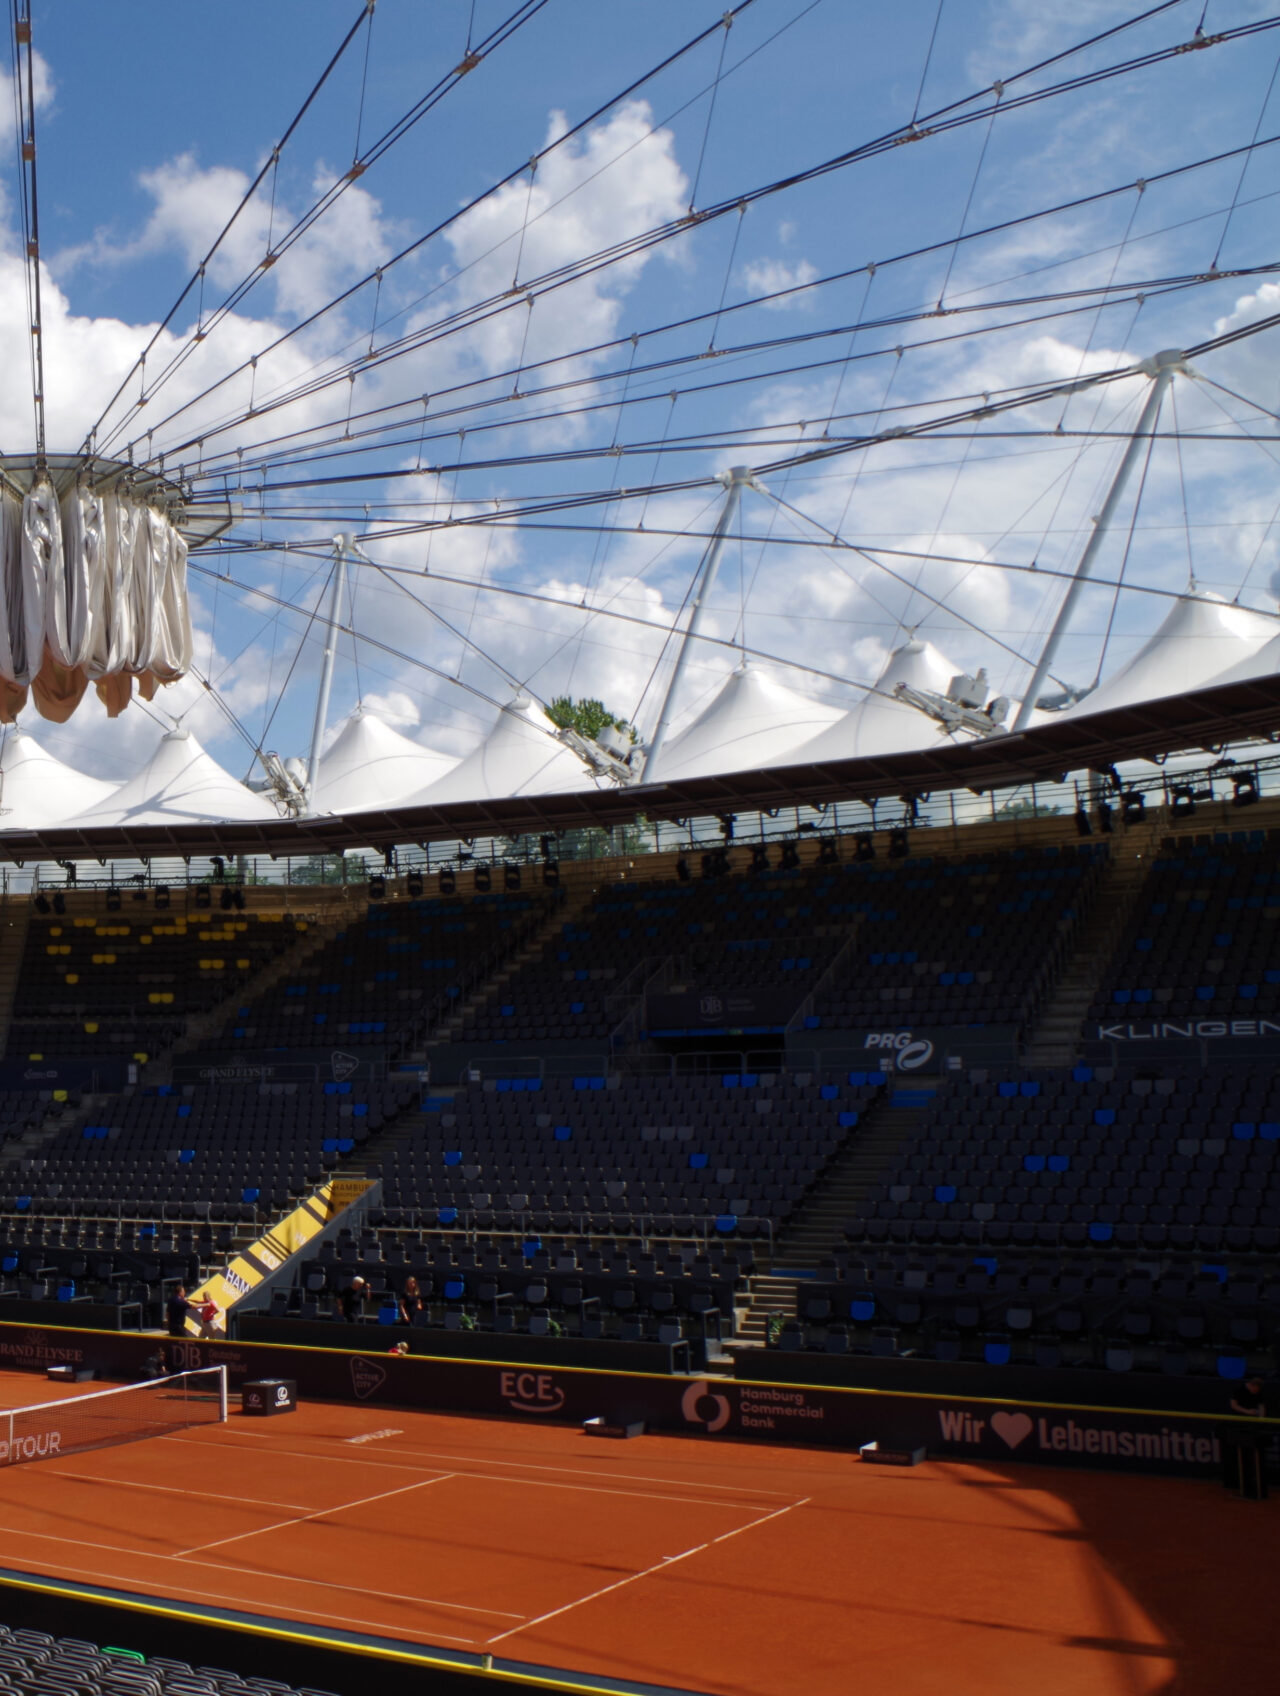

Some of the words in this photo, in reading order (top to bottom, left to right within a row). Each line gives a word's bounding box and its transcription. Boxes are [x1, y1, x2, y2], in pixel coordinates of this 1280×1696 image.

[864, 1032, 912, 1049] PRG
[171, 1341, 202, 1370] DTB
[355, 1373, 380, 1383] ACTIVE
[356, 1381, 372, 1389] CITY
[499, 1371, 555, 1400] ECE
[740, 1387, 805, 1406] Hamburg
[740, 1400, 824, 1419] Commercial
[740, 1415, 775, 1429] Bank
[12, 1430, 62, 1460] TOUR
[938, 1409, 986, 1444] Wir
[1038, 1417, 1223, 1465] Lebensmittel
